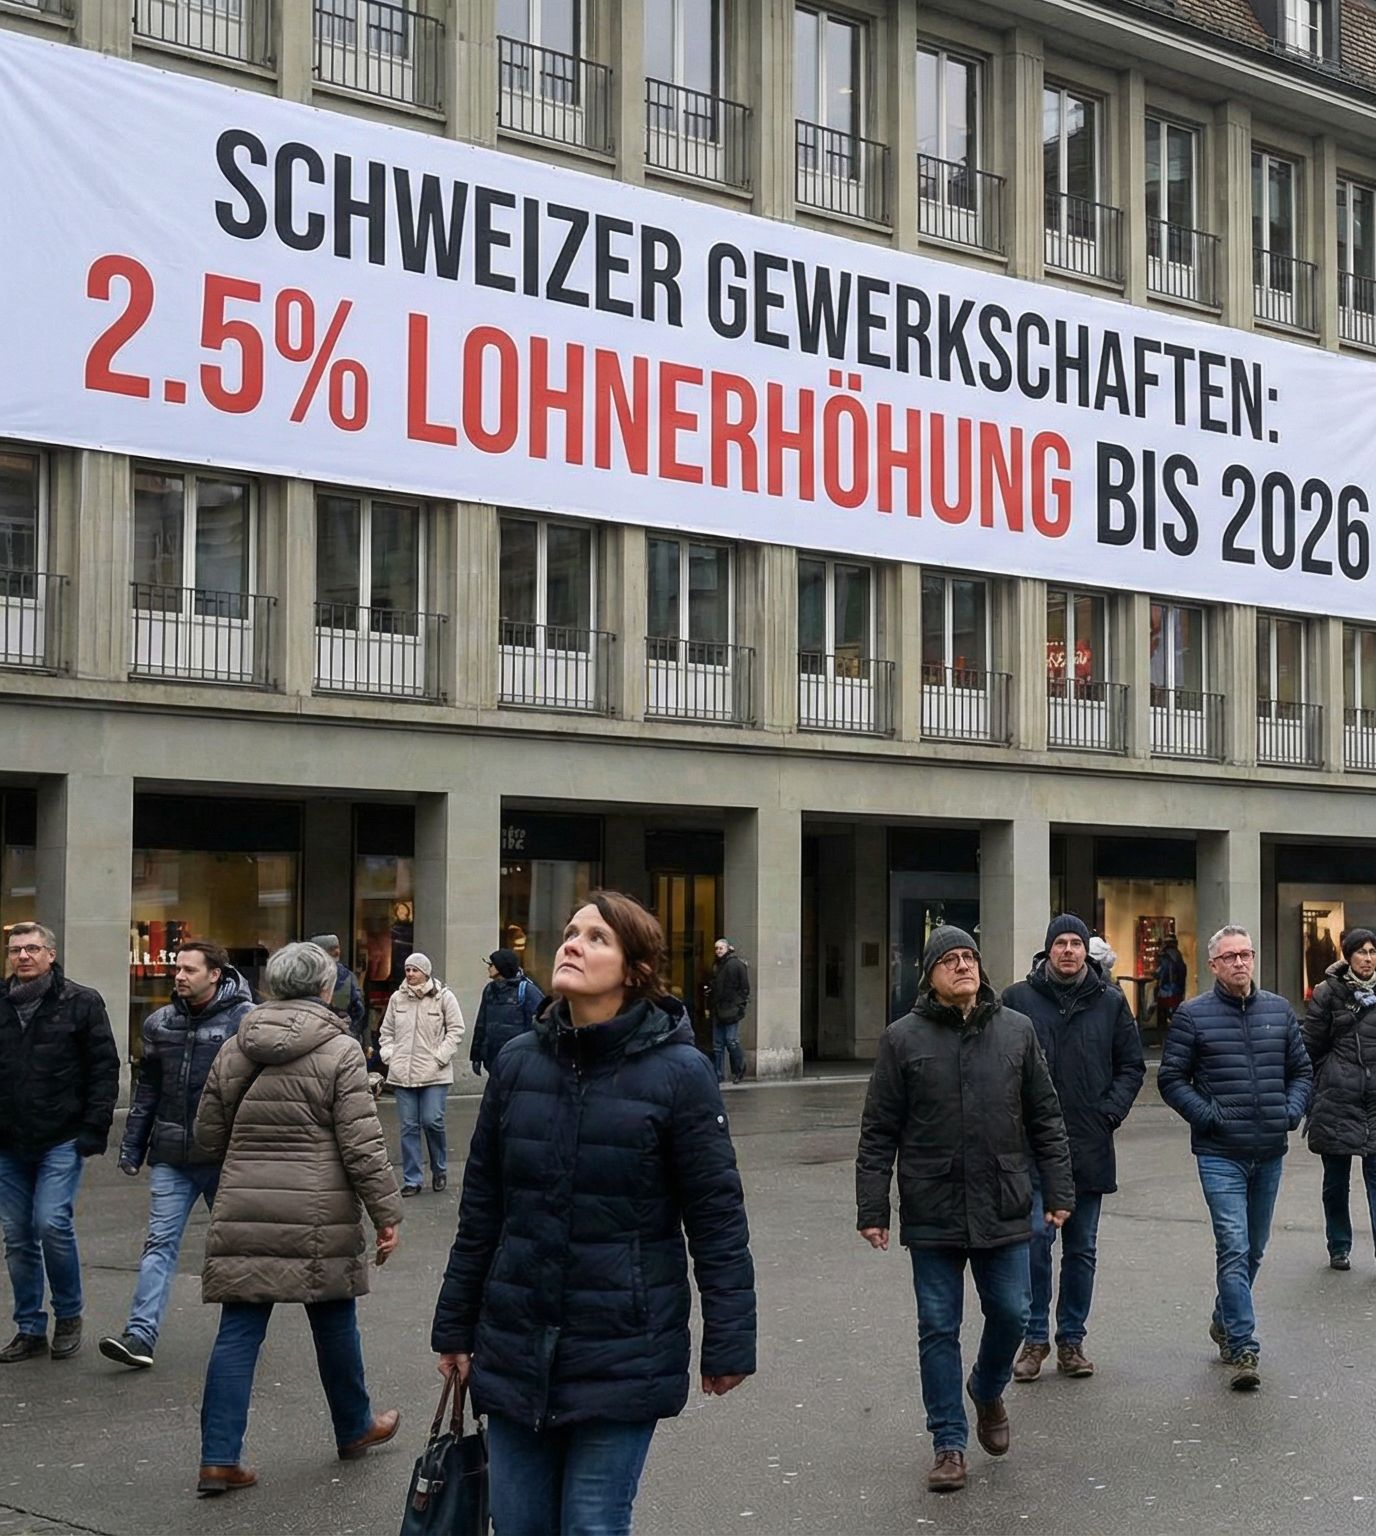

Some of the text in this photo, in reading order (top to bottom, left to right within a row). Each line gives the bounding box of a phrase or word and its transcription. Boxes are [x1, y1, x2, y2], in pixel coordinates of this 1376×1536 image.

[84, 254, 1370, 581] 2.5% LOHNERHÖHUNG BIS 2026
[215, 129, 1279, 444] SCHWEIZER GEWERKSCHAFTEN:
